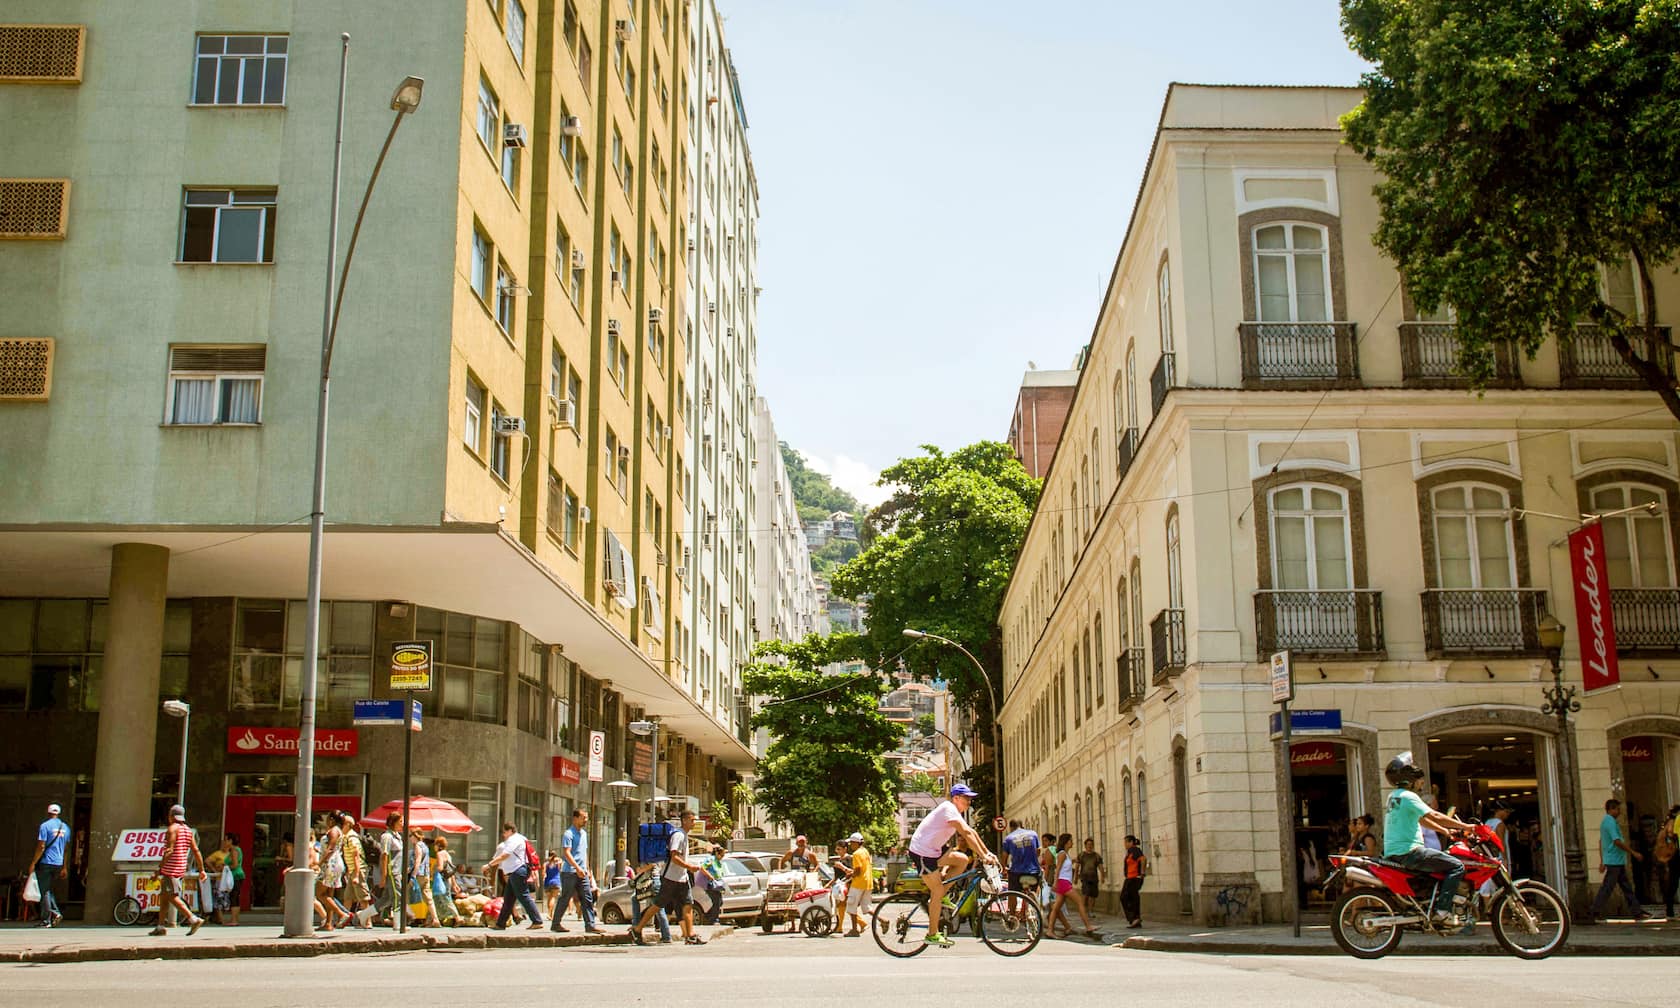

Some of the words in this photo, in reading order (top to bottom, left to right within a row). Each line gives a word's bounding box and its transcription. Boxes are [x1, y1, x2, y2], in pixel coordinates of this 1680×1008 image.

[1581, 535, 1609, 677] Leader
[263, 734, 352, 751] Santnder
[1291, 748, 1333, 763] Leader
[1622, 744, 1651, 758] ader
[124, 832, 168, 844] CUSC
